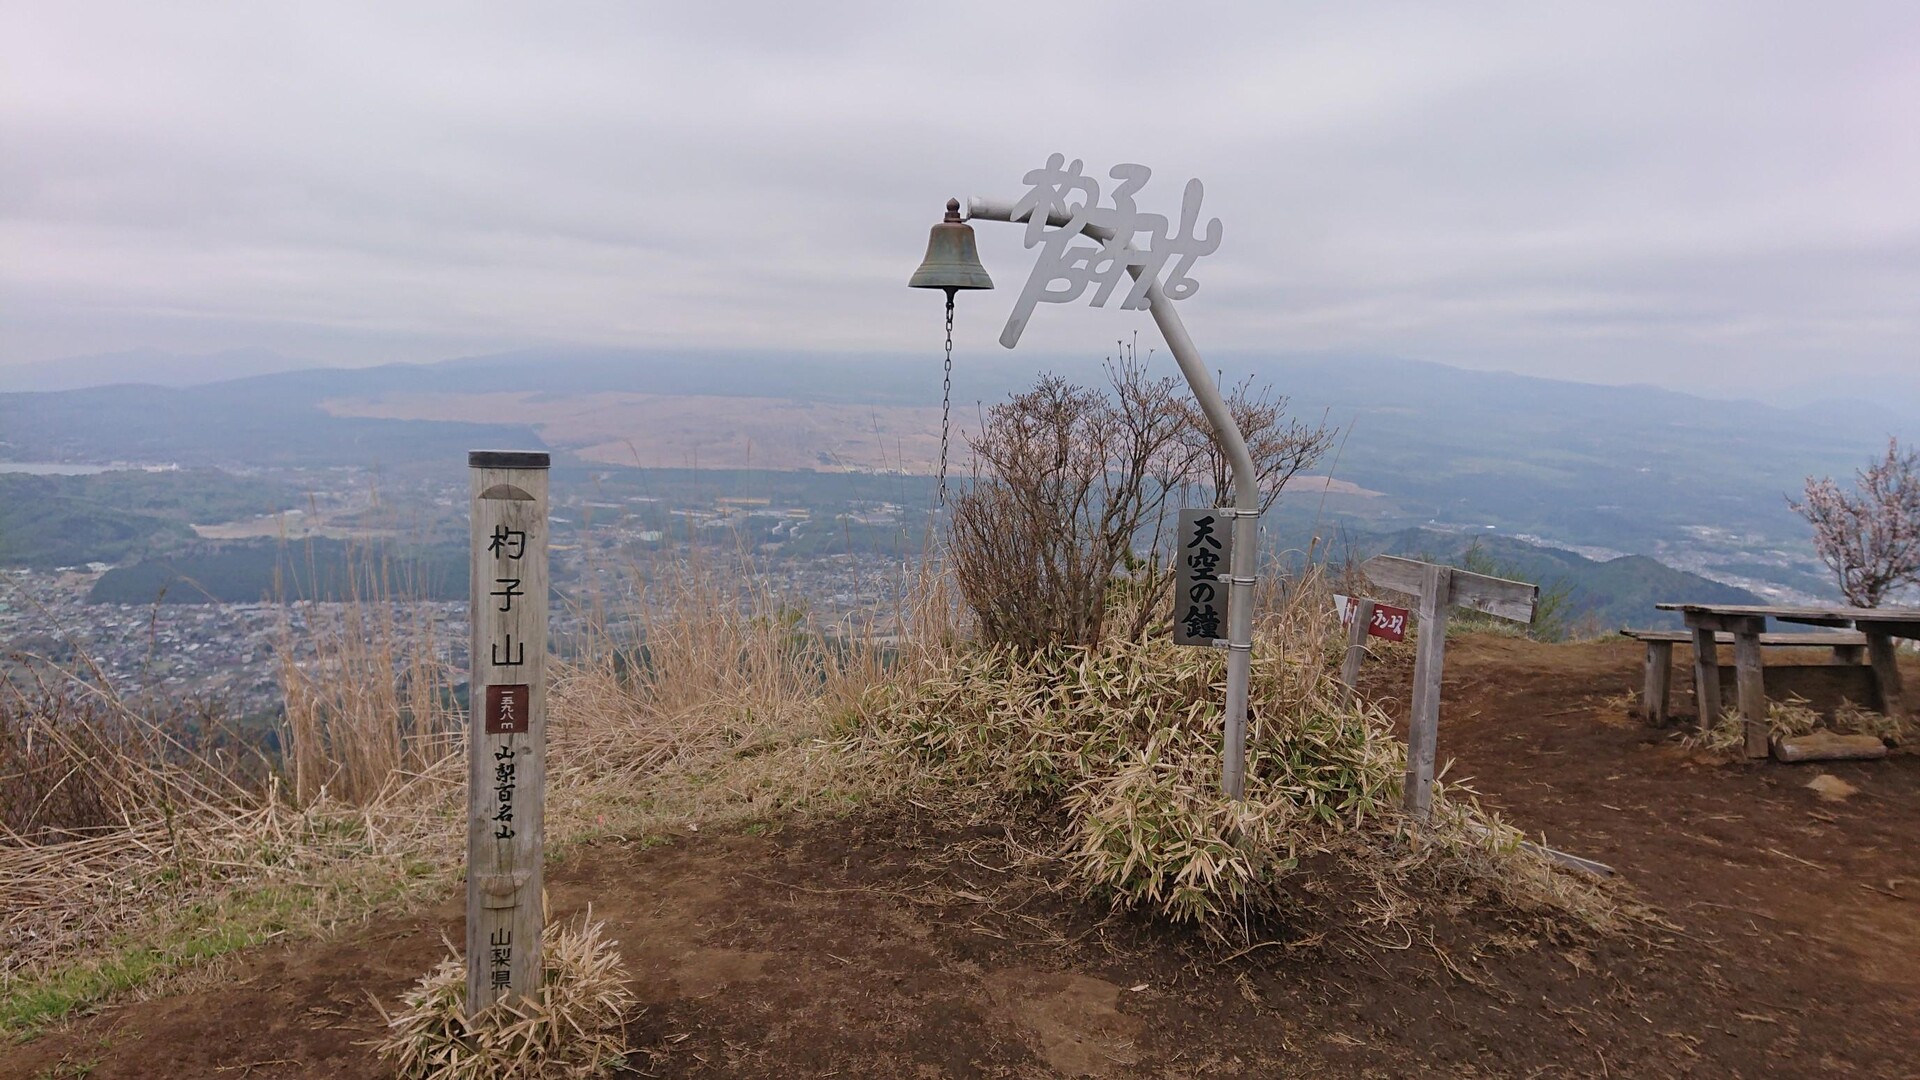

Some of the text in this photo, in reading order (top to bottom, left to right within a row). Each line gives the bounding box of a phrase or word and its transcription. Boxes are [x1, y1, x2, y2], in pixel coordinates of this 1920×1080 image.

[488, 524, 525, 666] 杓子山
[1181, 515, 1222, 639] 天空の鐘
[491, 746, 515, 840] 山梨百名山
[490, 927, 512, 991] 山梨県
